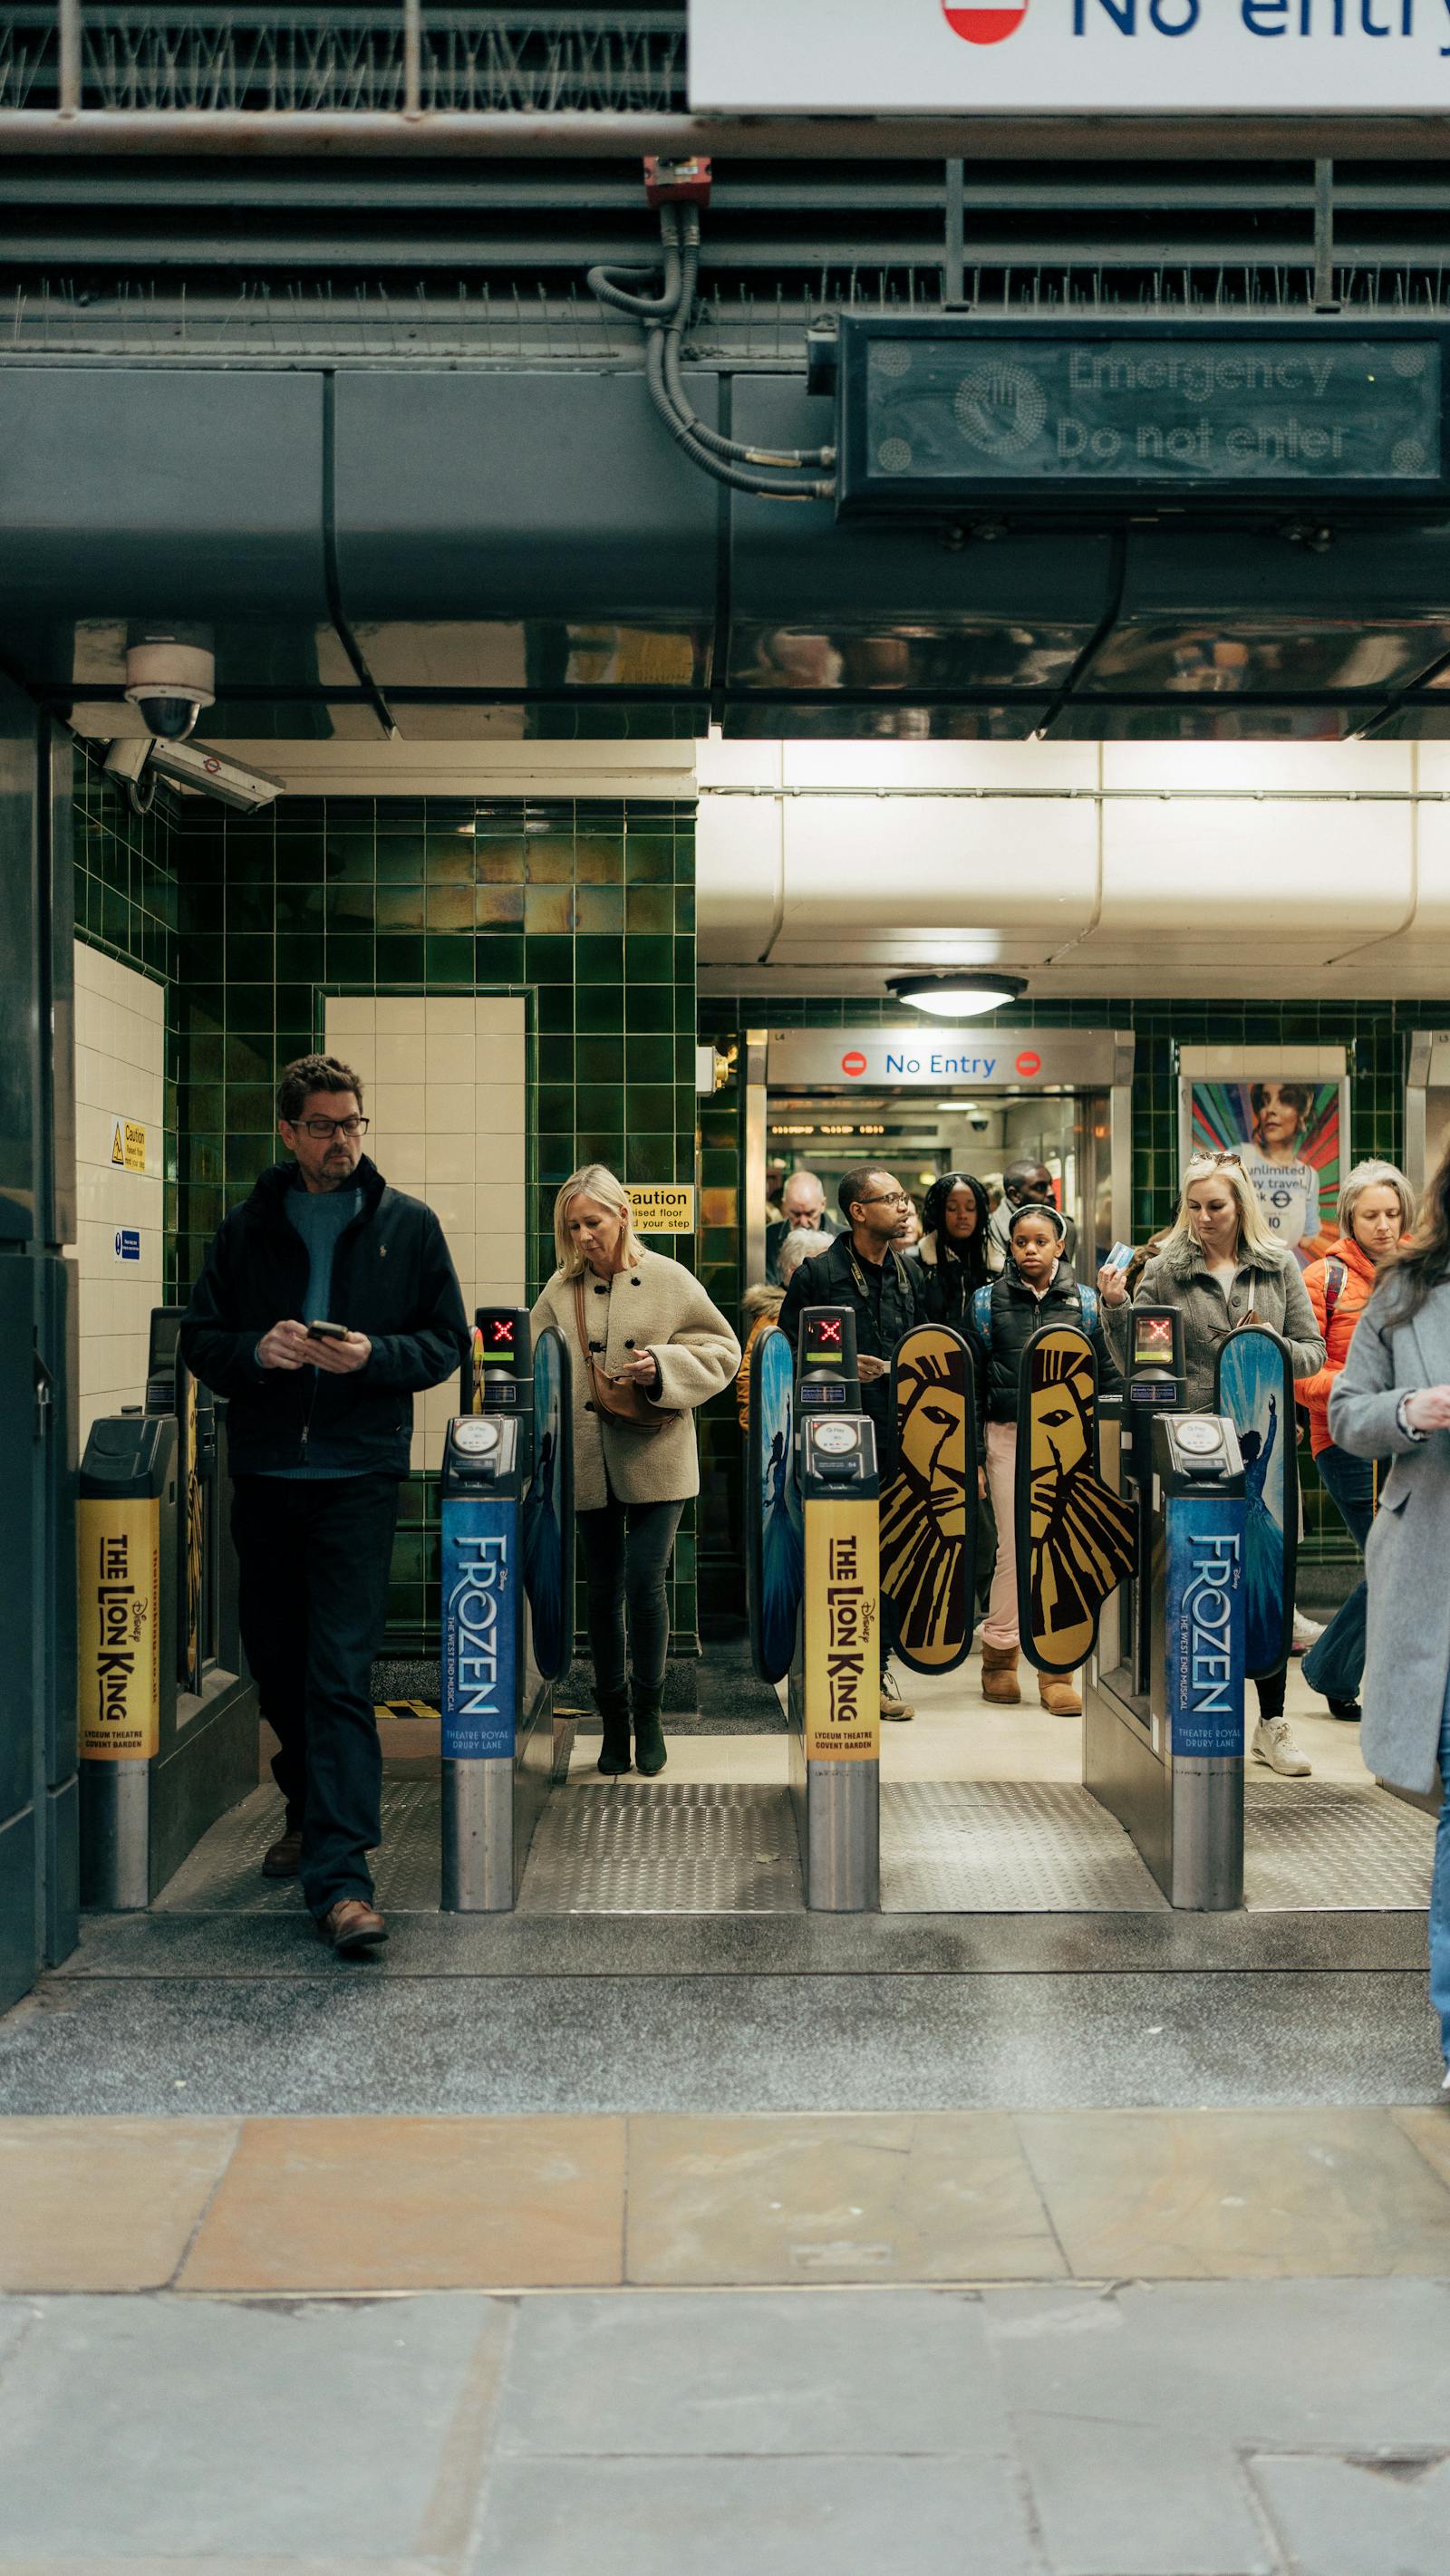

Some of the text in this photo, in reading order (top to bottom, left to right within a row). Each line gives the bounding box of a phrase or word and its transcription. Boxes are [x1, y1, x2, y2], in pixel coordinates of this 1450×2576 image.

[1073, 0, 1201, 36] No
[1069, 349, 1334, 402] Emergency
[1057, 417, 1350, 458] Do not enter
[775, 1033, 785, 1041] L4
[885, 1055, 997, 1078] No Entry
[125, 1124, 145, 1144] Caution
[633, 1209, 682, 1217] ised floor
[643, 1220, 663, 1229] your
[668, 1220, 690, 1229] step
[96, 1534, 135, 1721] THE LION KING
[449, 1534, 507, 1713] FROZEN
[826, 1535, 864, 1721] THE LION KING
[1182, 1533, 1240, 1713] FROZEN
[447, 1731, 508, 1740] THEATRE ROYAL
[815, 1732, 842, 1740] LYCEUM
[1179, 1729, 1240, 1738] THEATRE ROYAL
[1185, 1739, 1235, 1747] DRURY LANE
[453, 1741, 502, 1749] DRURY LANE
